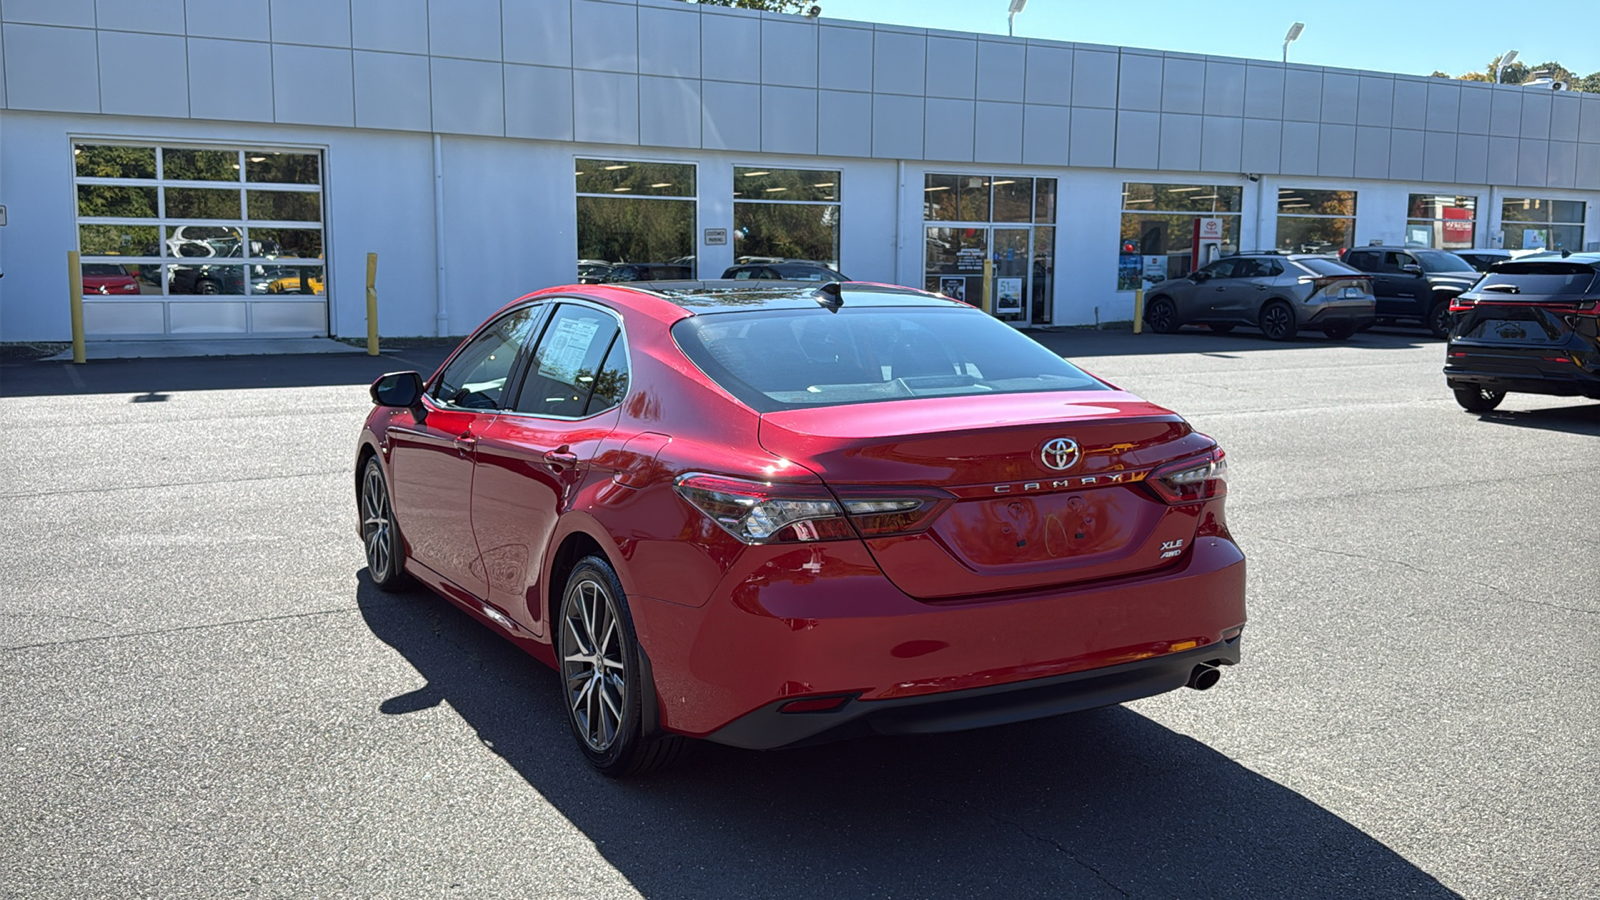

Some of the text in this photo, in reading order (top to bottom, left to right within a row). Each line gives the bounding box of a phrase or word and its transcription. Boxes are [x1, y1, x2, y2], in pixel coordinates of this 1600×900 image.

[993, 474, 1122, 493] CAMRY
[1160, 539, 1183, 551] XLE
[1160, 549, 1181, 559] AWD
